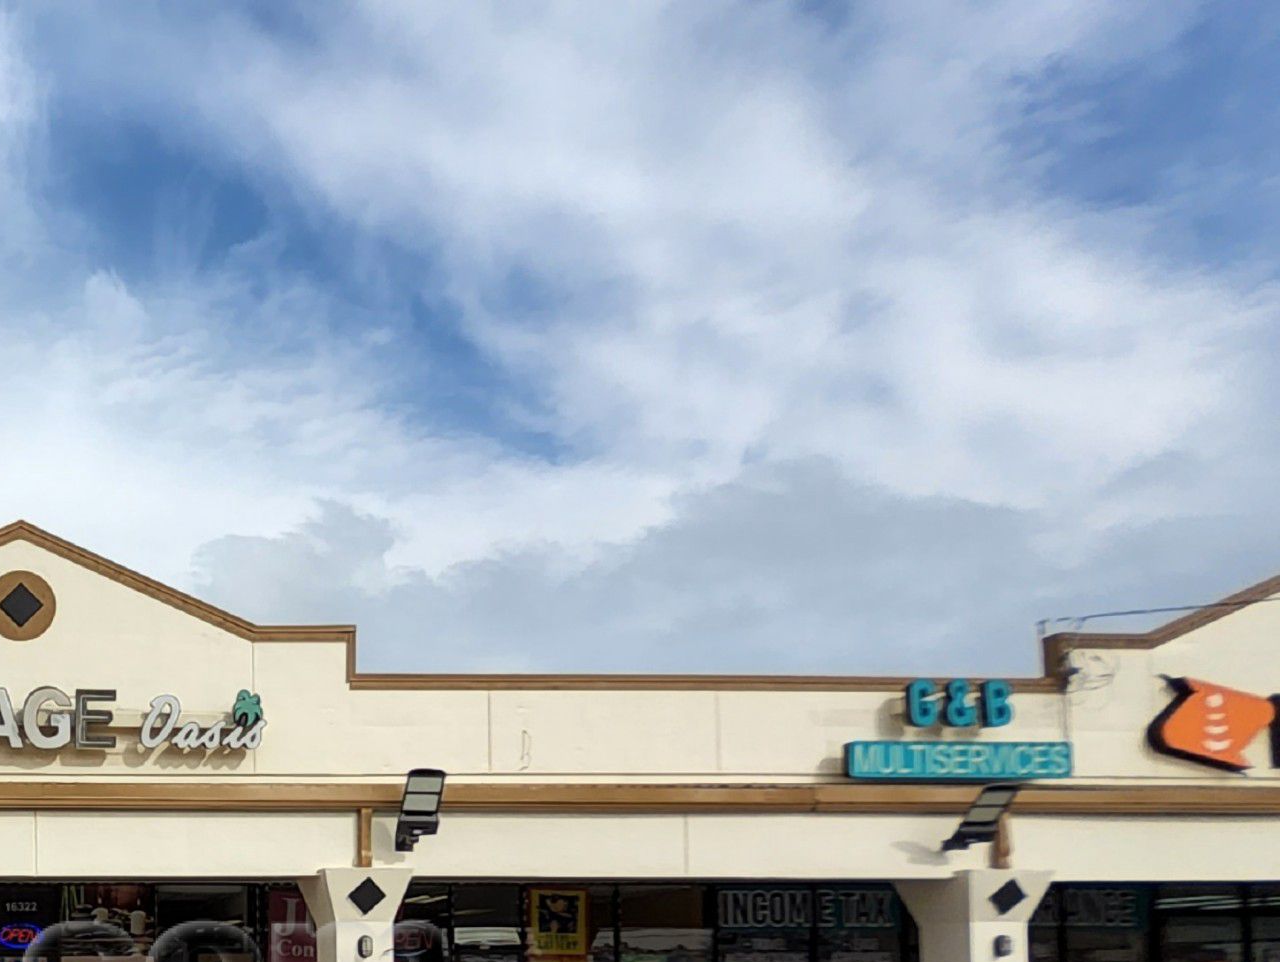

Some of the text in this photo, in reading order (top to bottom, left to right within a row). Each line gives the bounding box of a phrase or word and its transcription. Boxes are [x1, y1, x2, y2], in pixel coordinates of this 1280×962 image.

[140, 695, 268, 750] Oasis
[853, 743, 1070, 776] MULTISERVICES
[3, 901, 38, 913] 16322
[0, 927, 38, 946] OPEN
